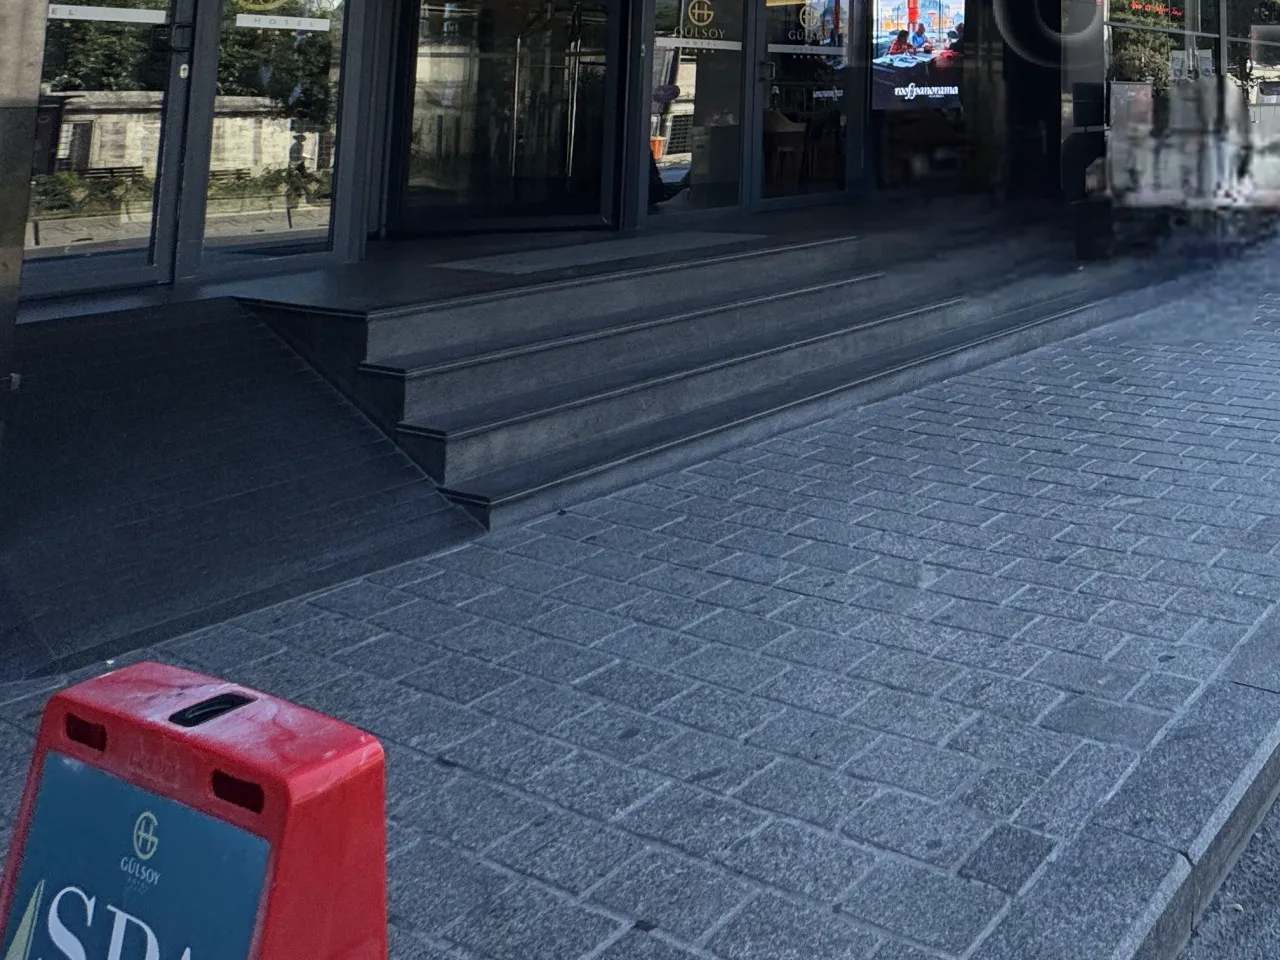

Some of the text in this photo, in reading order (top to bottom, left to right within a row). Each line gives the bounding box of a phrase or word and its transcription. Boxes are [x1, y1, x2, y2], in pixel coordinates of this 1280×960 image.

[674, 26, 726, 39] GÜLSOY
[120, 856, 161, 886] GÜLSOY
[48, 886, 191, 960] SP
